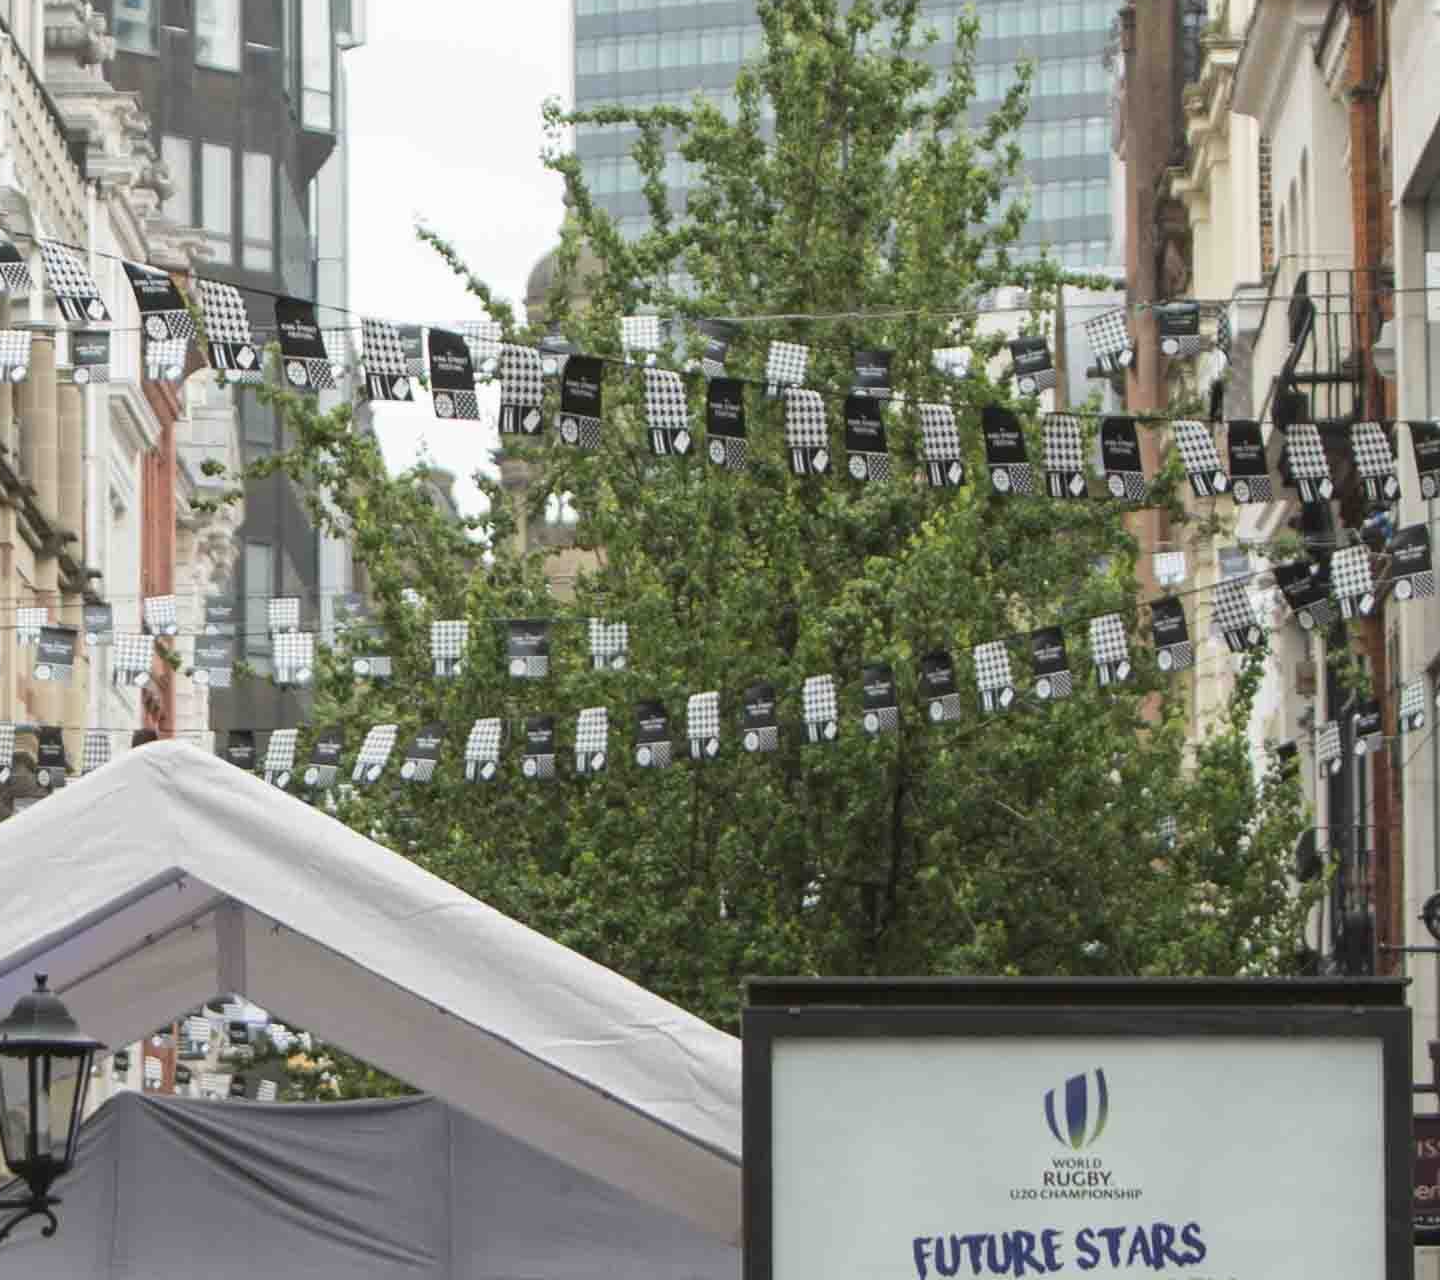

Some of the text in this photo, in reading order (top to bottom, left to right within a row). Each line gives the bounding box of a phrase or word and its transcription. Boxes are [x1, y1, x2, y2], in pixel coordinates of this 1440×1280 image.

[1052, 1157, 1103, 1169] WORLD
[1043, 1171, 1113, 1187] RUGBY
[1010, 1188, 1144, 1200] U20 CHAMPIONSHIP
[913, 1222, 1206, 1280] FUTURE STARS
